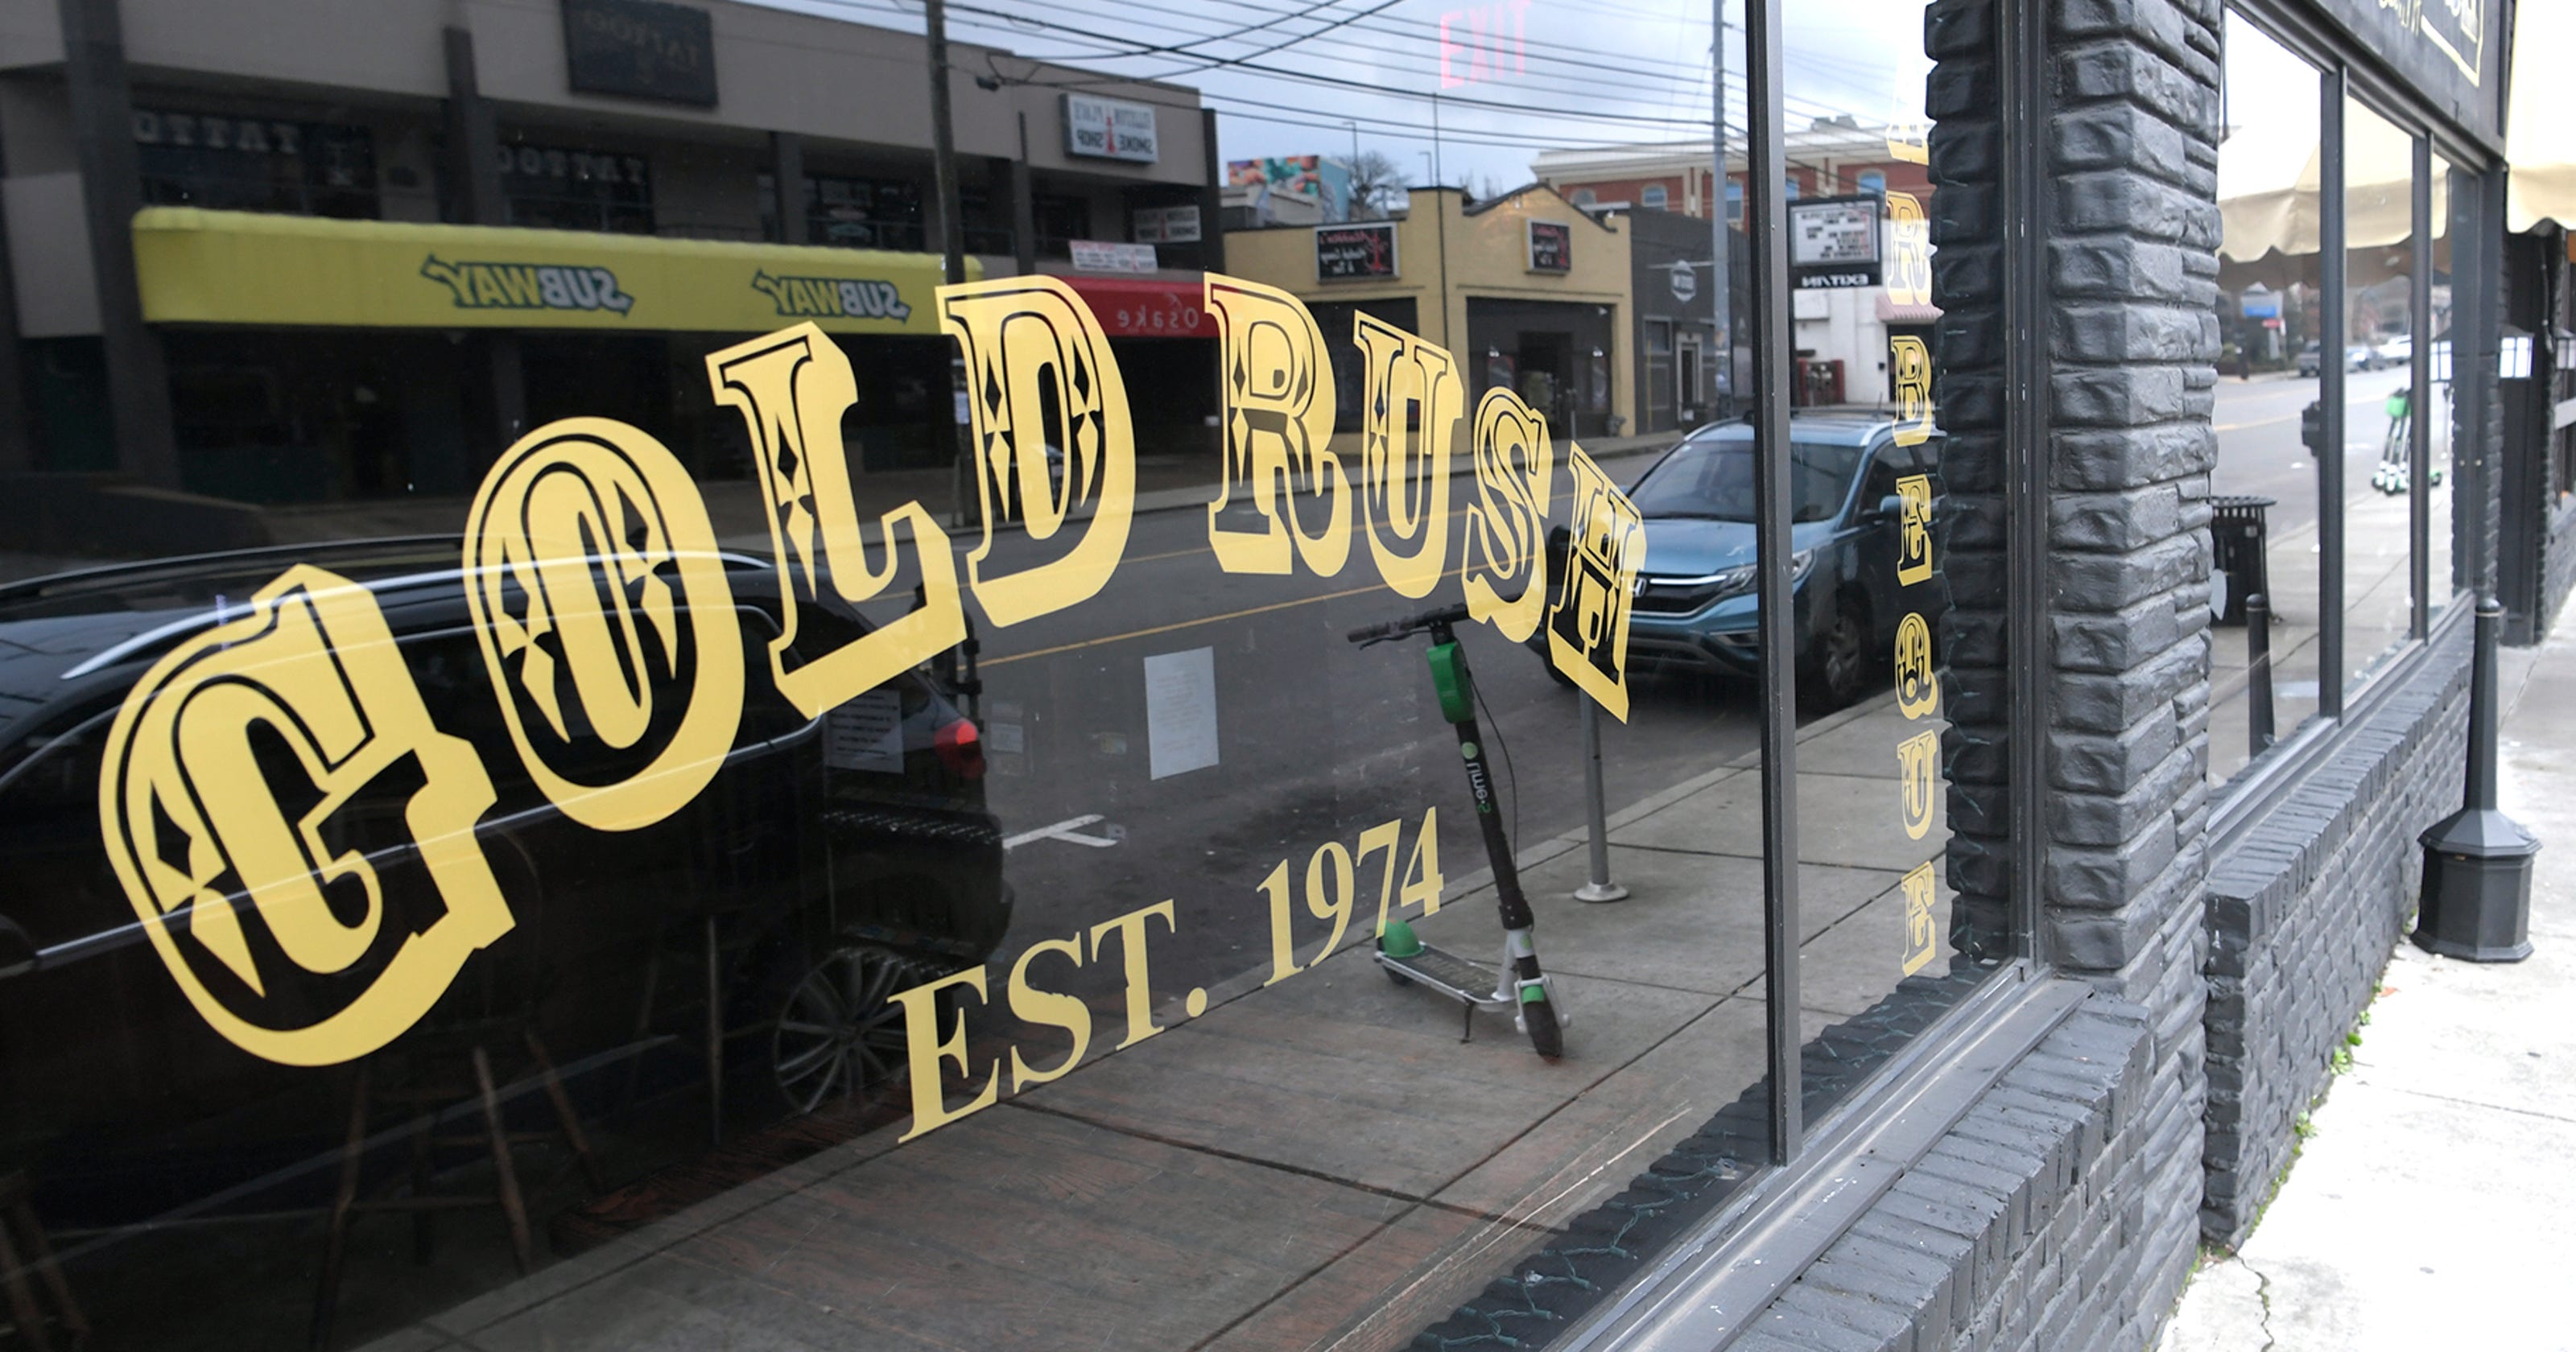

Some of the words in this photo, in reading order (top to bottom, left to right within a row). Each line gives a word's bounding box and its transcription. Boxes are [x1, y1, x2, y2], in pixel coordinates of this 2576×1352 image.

[1440, 0, 1531, 89] EXIT
[99, 275, 1136, 1066] GOLD
[1203, 271, 1647, 724] RUSH
[886, 899, 1208, 1144] EST.
[1256, 806, 1445, 987] 1974
